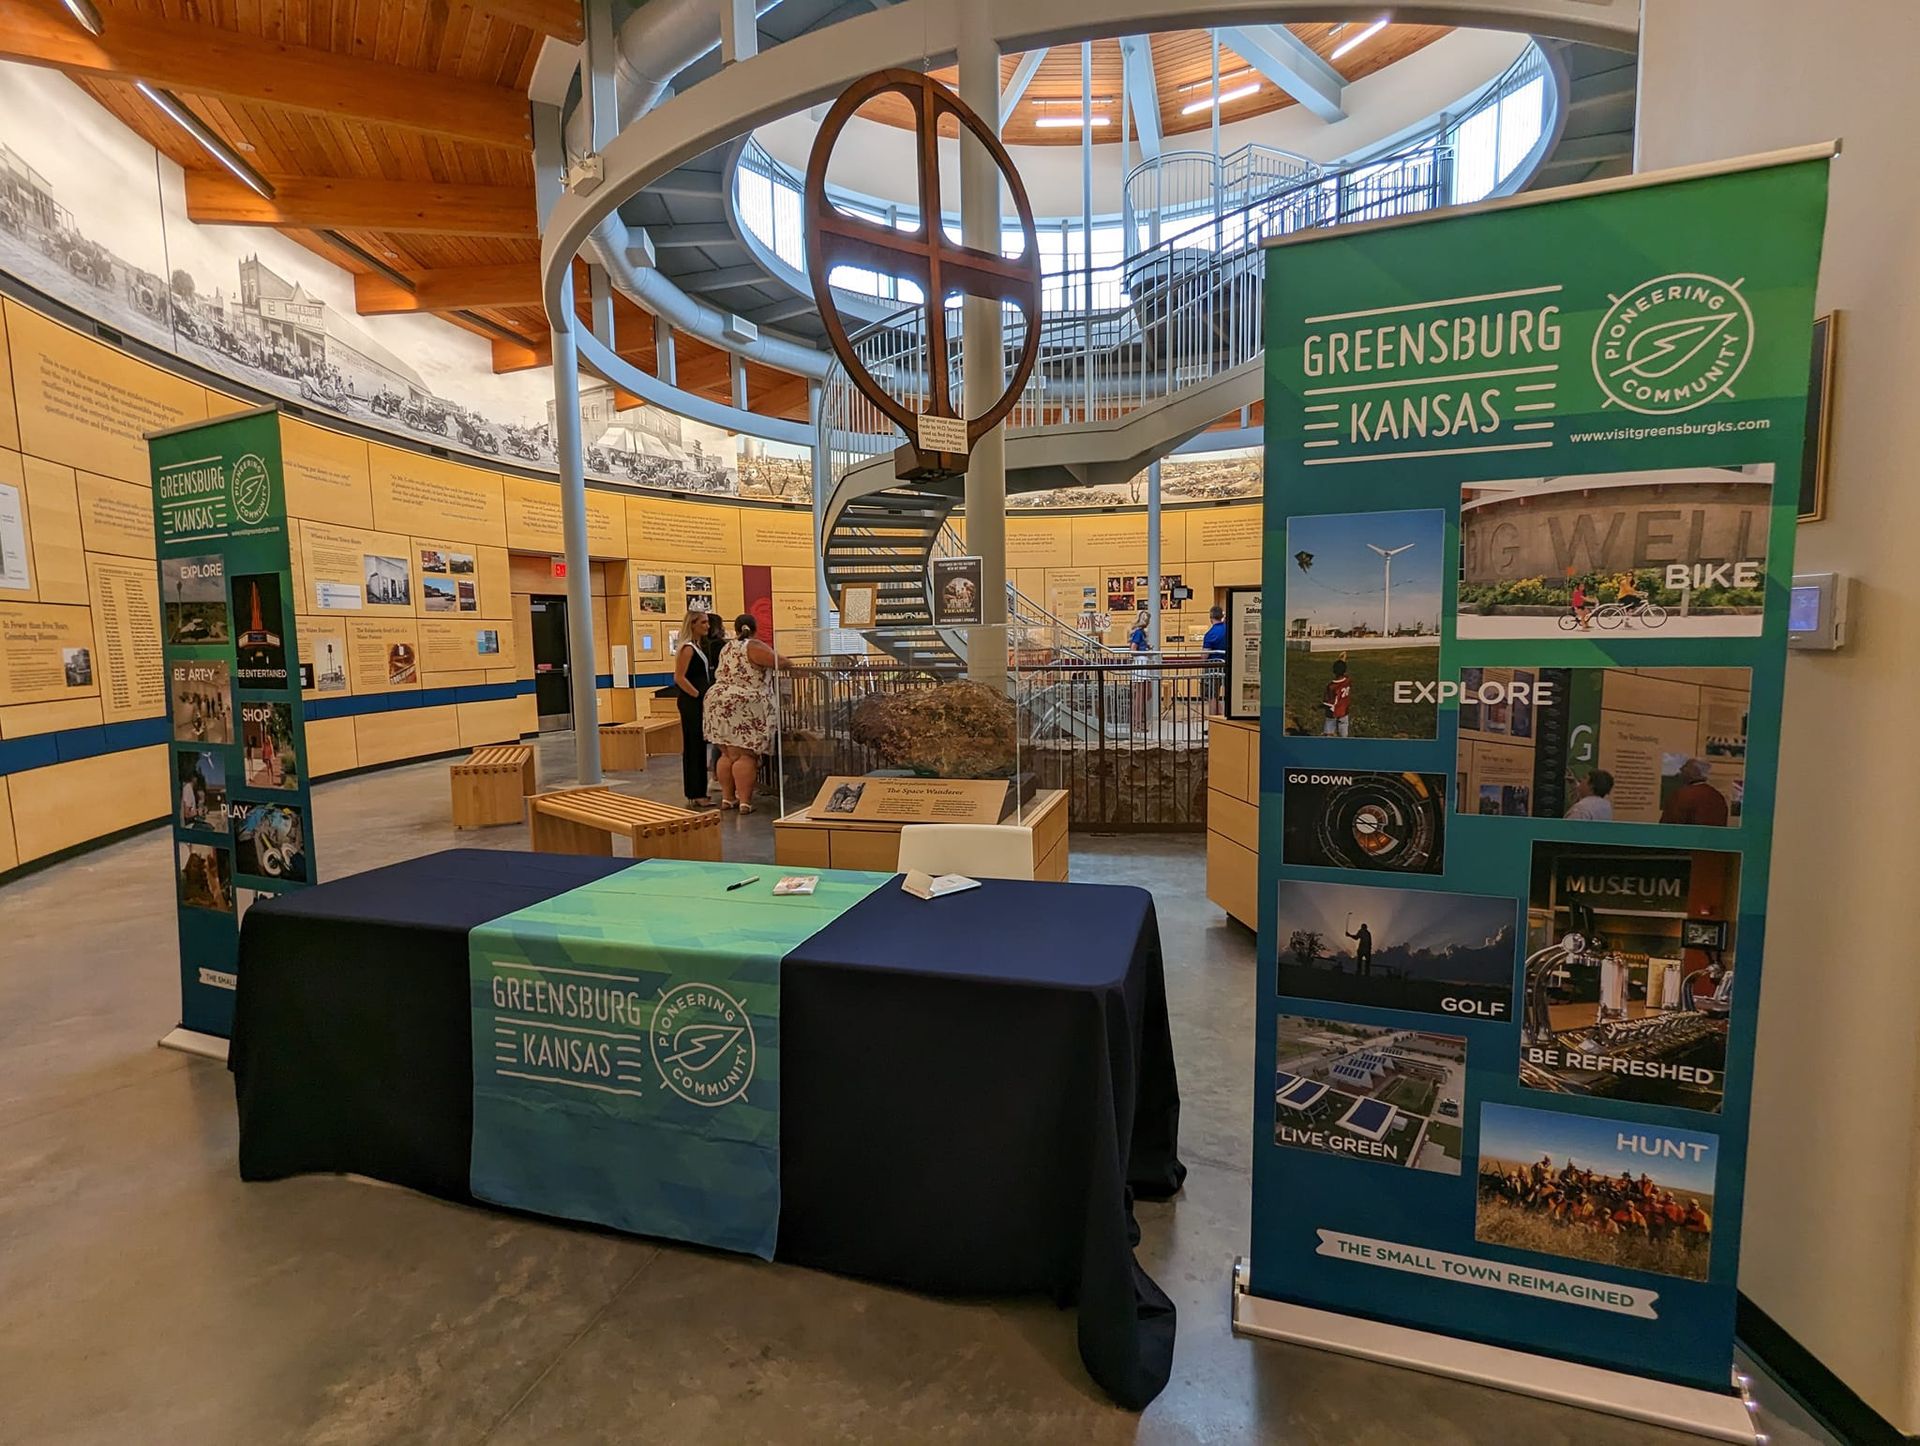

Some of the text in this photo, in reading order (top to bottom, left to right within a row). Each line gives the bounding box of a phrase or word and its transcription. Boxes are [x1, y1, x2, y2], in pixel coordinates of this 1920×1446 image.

[1605, 286, 1724, 359] PIONEERING
[1303, 305, 1563, 377] GREENSBURG
[1622, 333, 1739, 403] COMMUNITY
[1350, 388, 1501, 444] KANSAS
[1570, 418, 1770, 444] www.visitgreensburgks.com
[160, 466, 225, 499] GREENSBURG
[174, 506, 214, 532] KANSAS
[181, 563, 222, 579] EXPLORE
[1665, 561, 1759, 590] BIKE
[174, 668, 215, 681] BE ART-Y
[238, 669, 287, 678] BE ENTERTAINED
[1394, 681, 1554, 706] EXPLORE
[242, 708, 271, 722] SHOP
[902, 788, 924, 796] Space
[926, 788, 964, 796] Wanderer
[1288, 774, 1352, 786] GO DOWN
[220, 802, 248, 820] PLAY
[1566, 874, 1682, 898] MUSEUM
[492, 975, 642, 1026] GREENSBURG
[1440, 996, 1506, 1017] GOLF
[659, 993, 736, 1046] PIONEERING
[523, 1032, 612, 1078] KANSAS
[1528, 1048, 1714, 1086] BE REFRESHED
[672, 1044, 747, 1096] COMMUNITY
[1280, 1128, 1398, 1160] LIVE GREEN
[1616, 1132, 1710, 1162] HUNT
[1336, 1240, 1634, 1308] THE SMALL TOWN REIMAGINED
